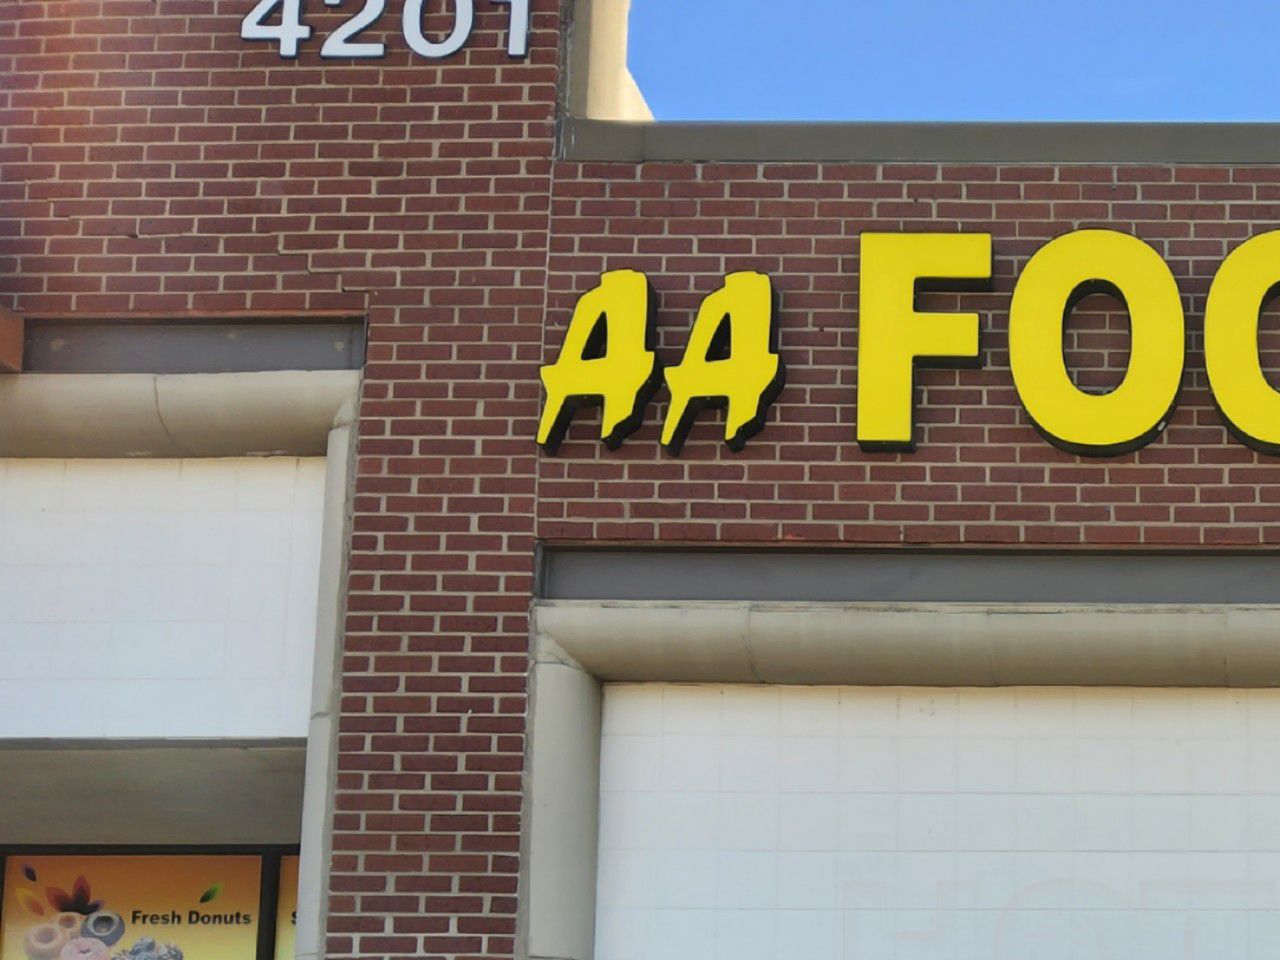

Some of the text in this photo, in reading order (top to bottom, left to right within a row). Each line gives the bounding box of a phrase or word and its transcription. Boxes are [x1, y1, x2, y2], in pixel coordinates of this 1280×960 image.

[240, 0, 530, 58] 4201
[536, 268, 785, 455] AA
[131, 910, 252, 926] Fresh Donuts
